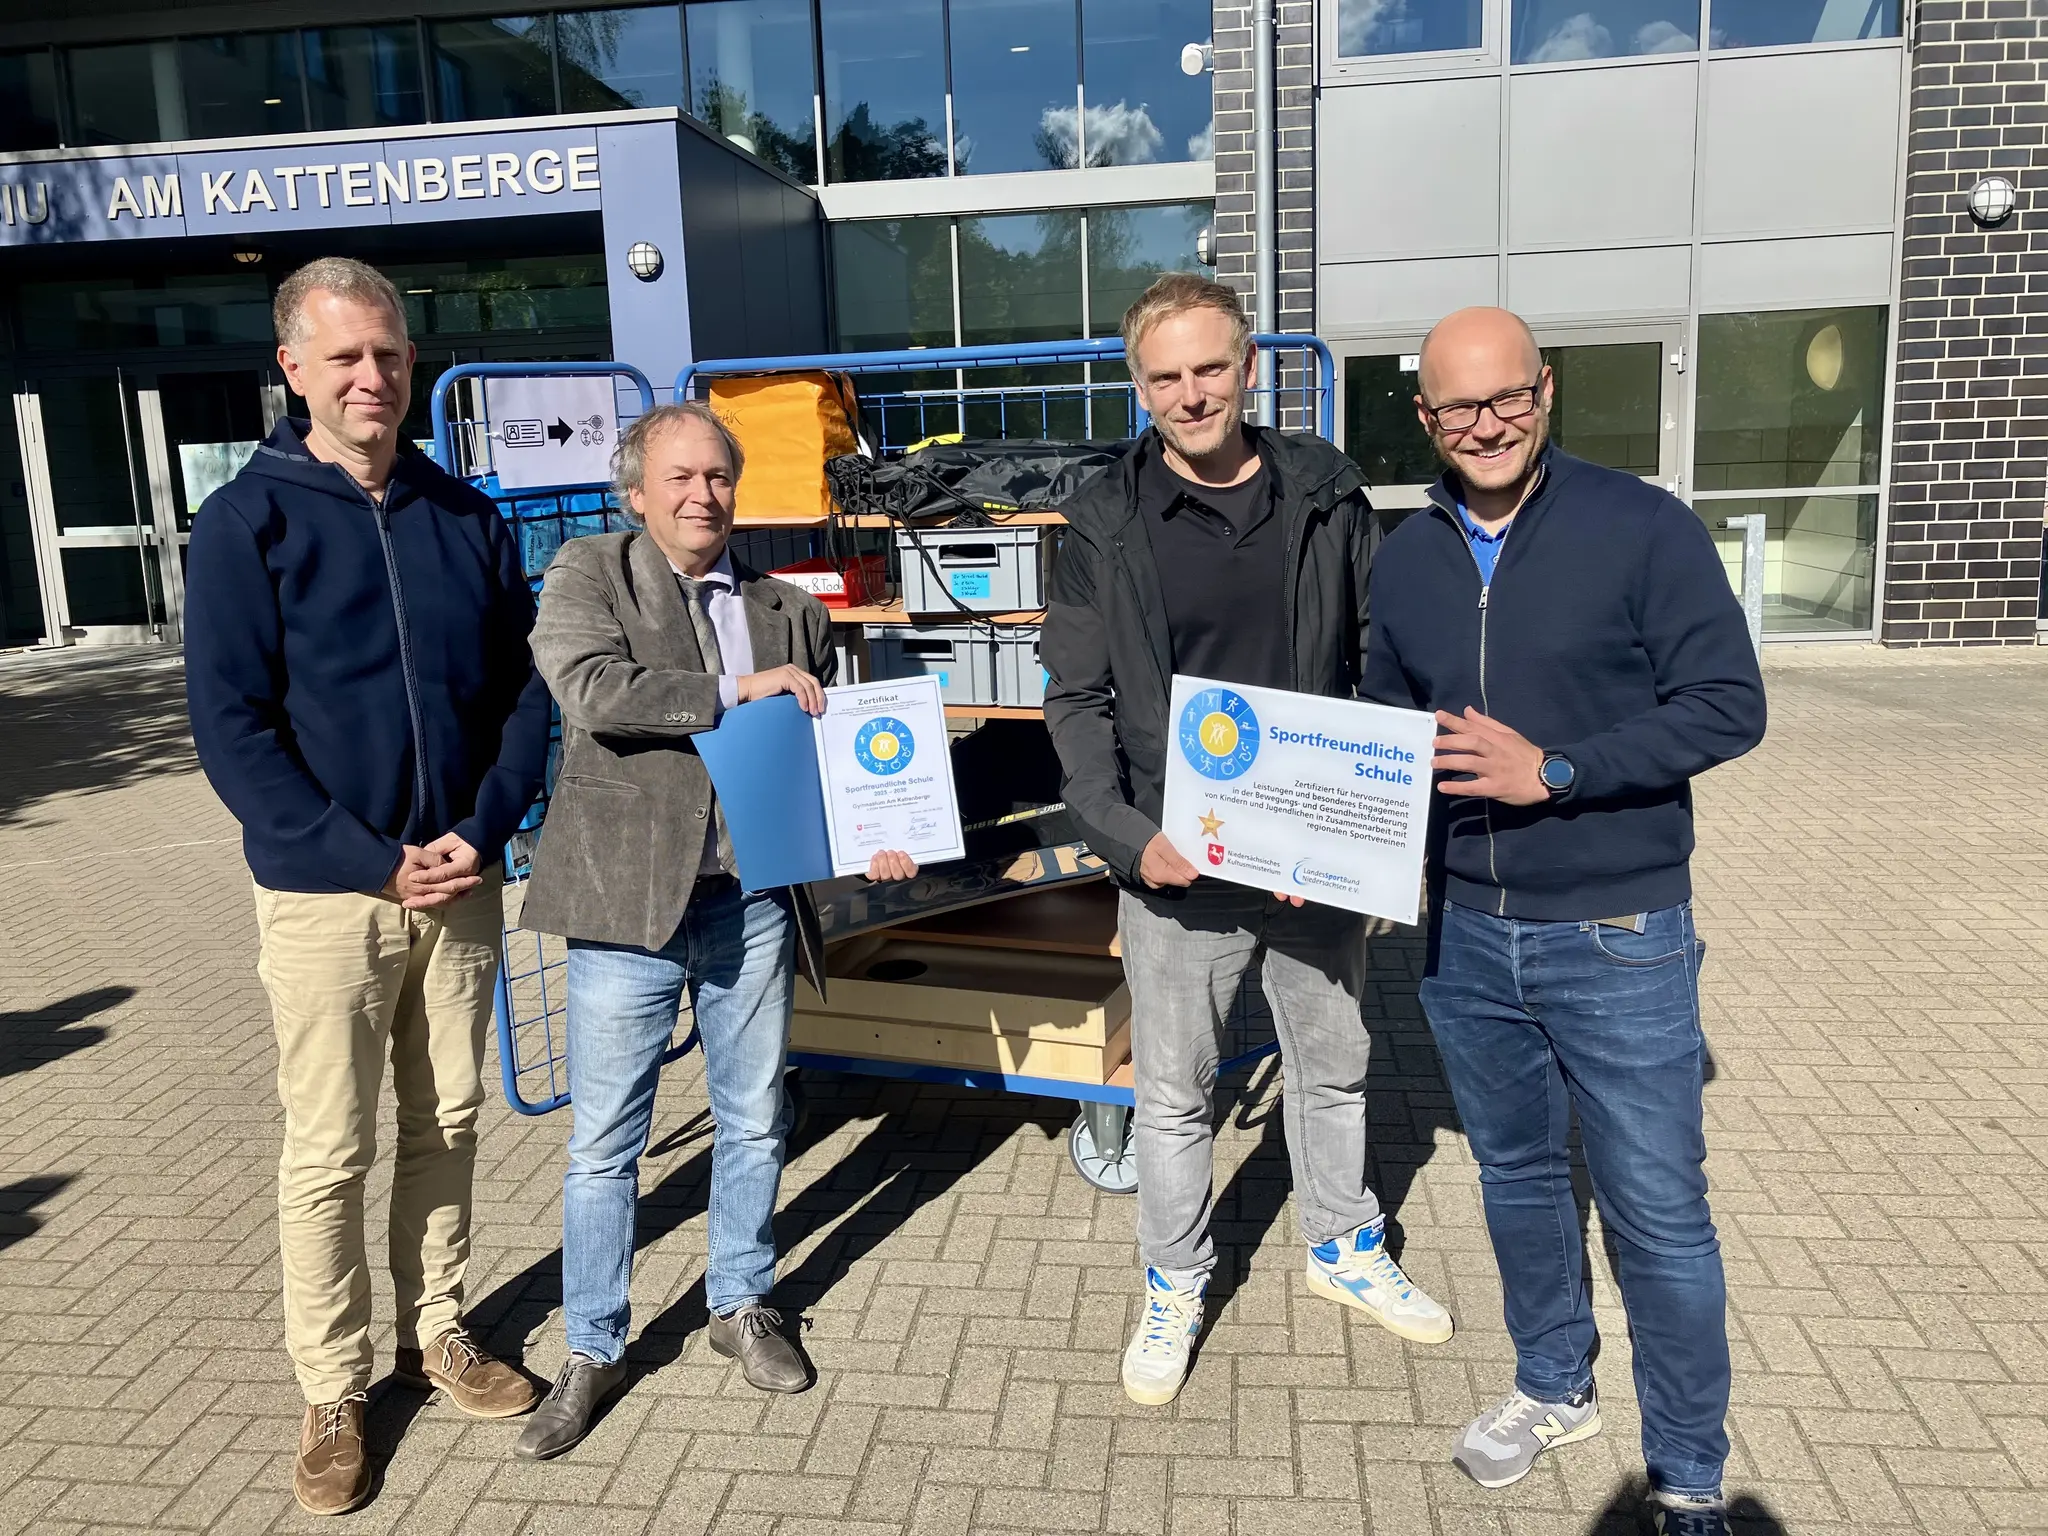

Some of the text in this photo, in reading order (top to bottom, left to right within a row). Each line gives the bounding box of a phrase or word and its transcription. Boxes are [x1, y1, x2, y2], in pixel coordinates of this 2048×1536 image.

[107, 174, 183, 220] AM
[201, 146, 601, 214] KATTENBERGE
[857, 694, 899, 706] Zertifikat
[1269, 726, 1415, 763] Sportfreundliche
[845, 776, 934, 794] Sportfreundliche Schule
[1355, 763, 1413, 786] Schule
[1253, 782, 1409, 819] Leistungen und besonderes Engagement
[1294, 780, 1410, 809] Zertifiziert für hervorragende
[1220, 794, 1248, 805] Kindern
[1249, 801, 1264, 809] und
[1265, 803, 1314, 819] Jugendlichen
[1316, 813, 1323, 821] in
[1325, 815, 1391, 836] Zusammenarbeit
[1393, 829, 1407, 839] mit
[1241, 789, 1254, 797] der
[1255, 792, 1301, 807] Bewegungs-
[1302, 801, 1317, 810] und
[1319, 804, 1408, 830] Gesundheitsförderung
[1306, 822, 1406, 848] regionalen Sportvereinen
[1227, 858, 1281, 875] Kultusministerium
[1228, 850, 1281, 867] Niedersächsisches
[1302, 875, 1347, 891] Niedersachsen
